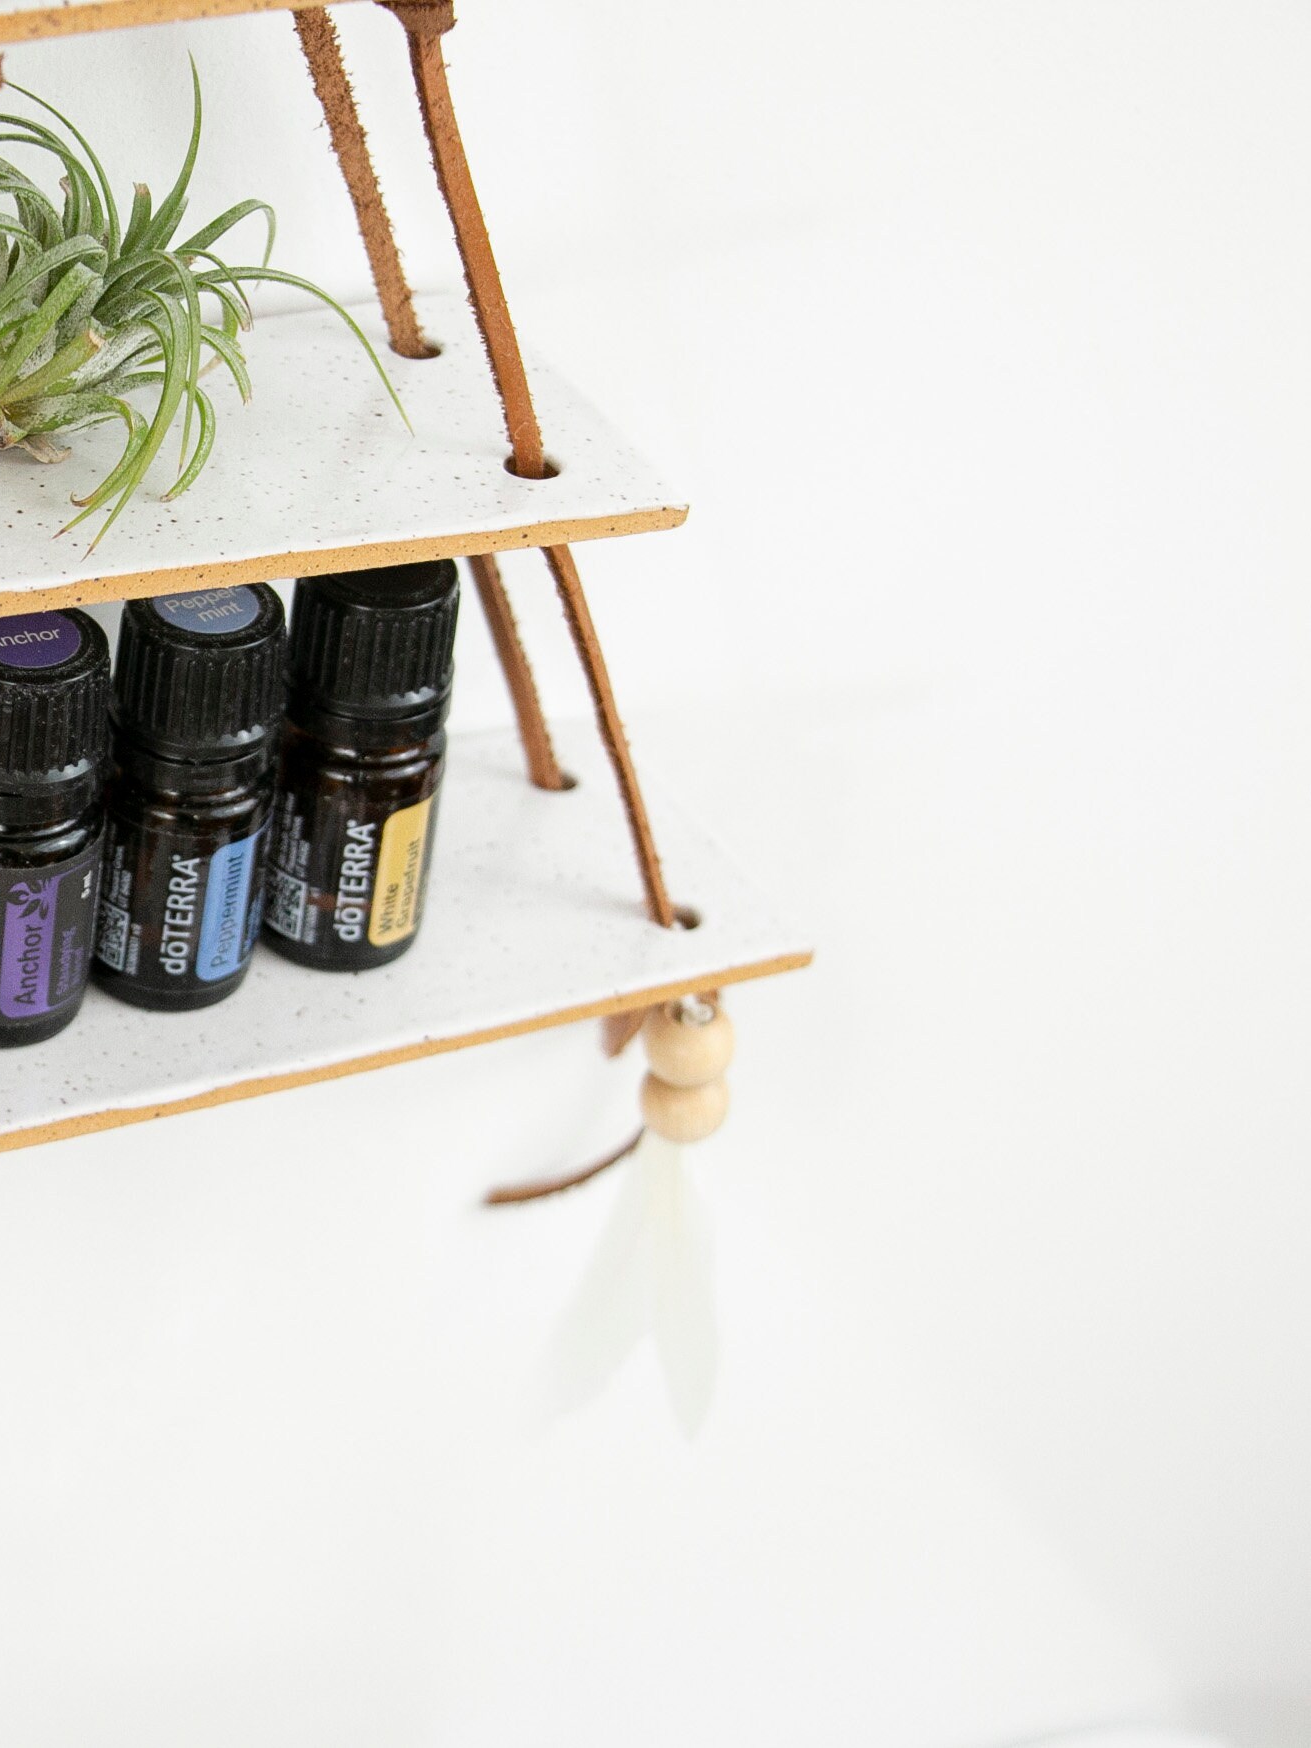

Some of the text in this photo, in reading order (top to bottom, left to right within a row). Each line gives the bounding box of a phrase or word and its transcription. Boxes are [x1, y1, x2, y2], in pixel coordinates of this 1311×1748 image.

[197, 601, 243, 622] mint
[210, 851, 246, 968] Peppermint
[377, 883, 399, 935] White
[395, 838, 420, 929] Grapefruit
[12, 924, 43, 1006] Anchor
